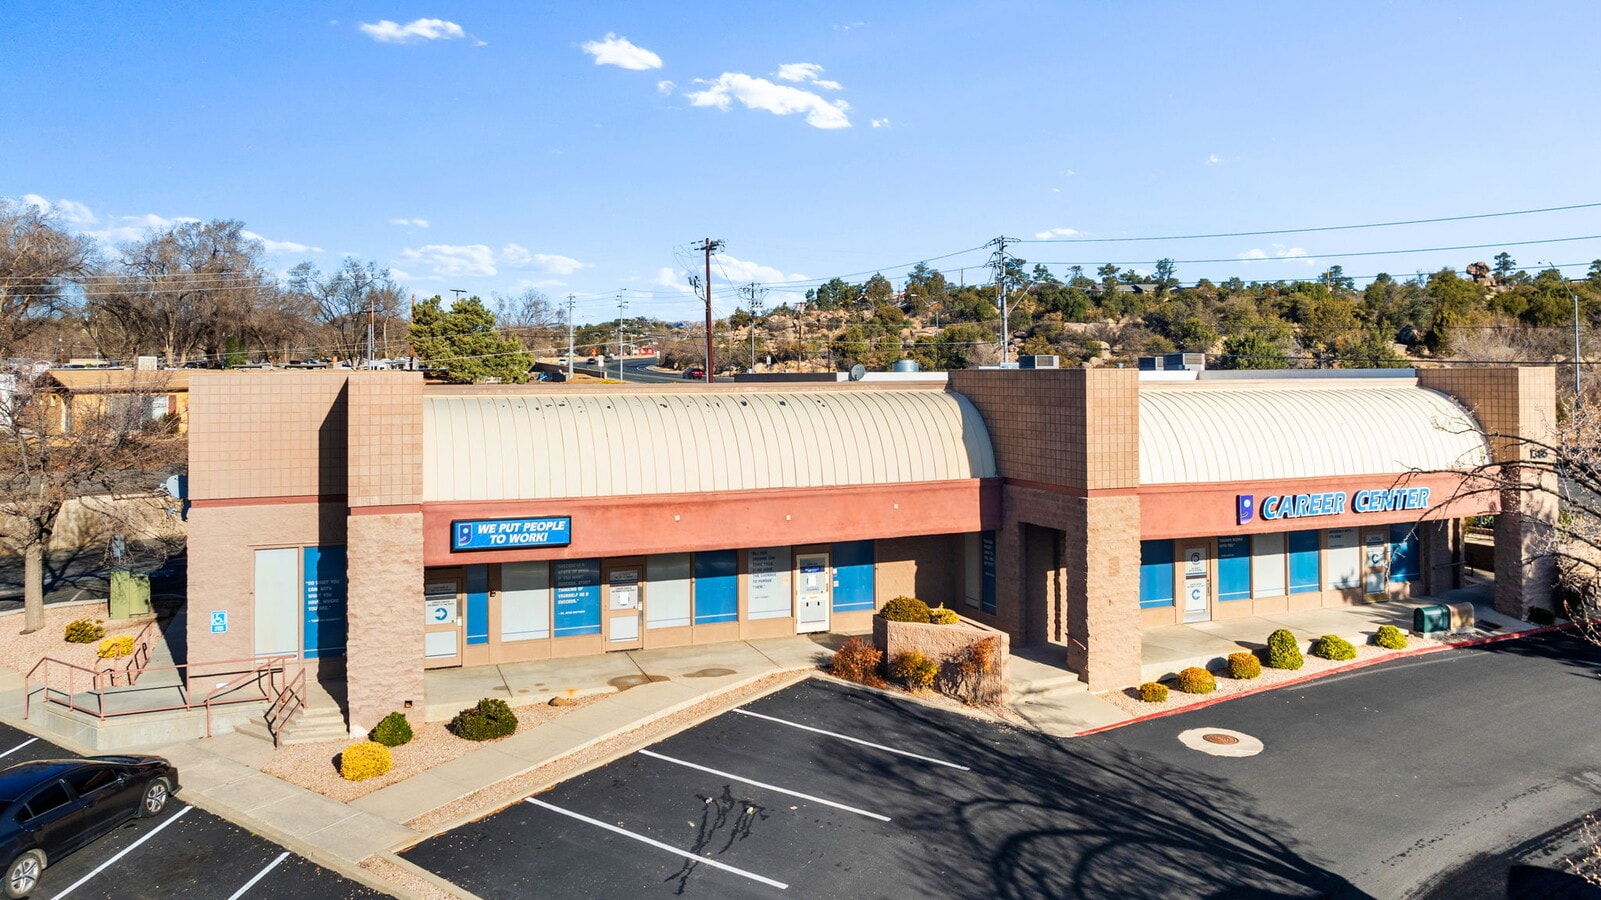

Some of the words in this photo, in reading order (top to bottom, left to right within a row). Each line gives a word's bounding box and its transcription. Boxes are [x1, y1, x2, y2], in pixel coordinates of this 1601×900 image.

[1261, 491, 1347, 520] CAREER
[1353, 486, 1431, 513] CENTER
[478, 524, 496, 534] WE
[499, 522, 521, 533] PUT
[523, 520, 566, 532] PEOPLE
[490, 534, 506, 545] TO
[510, 532, 549, 543] WORK!
